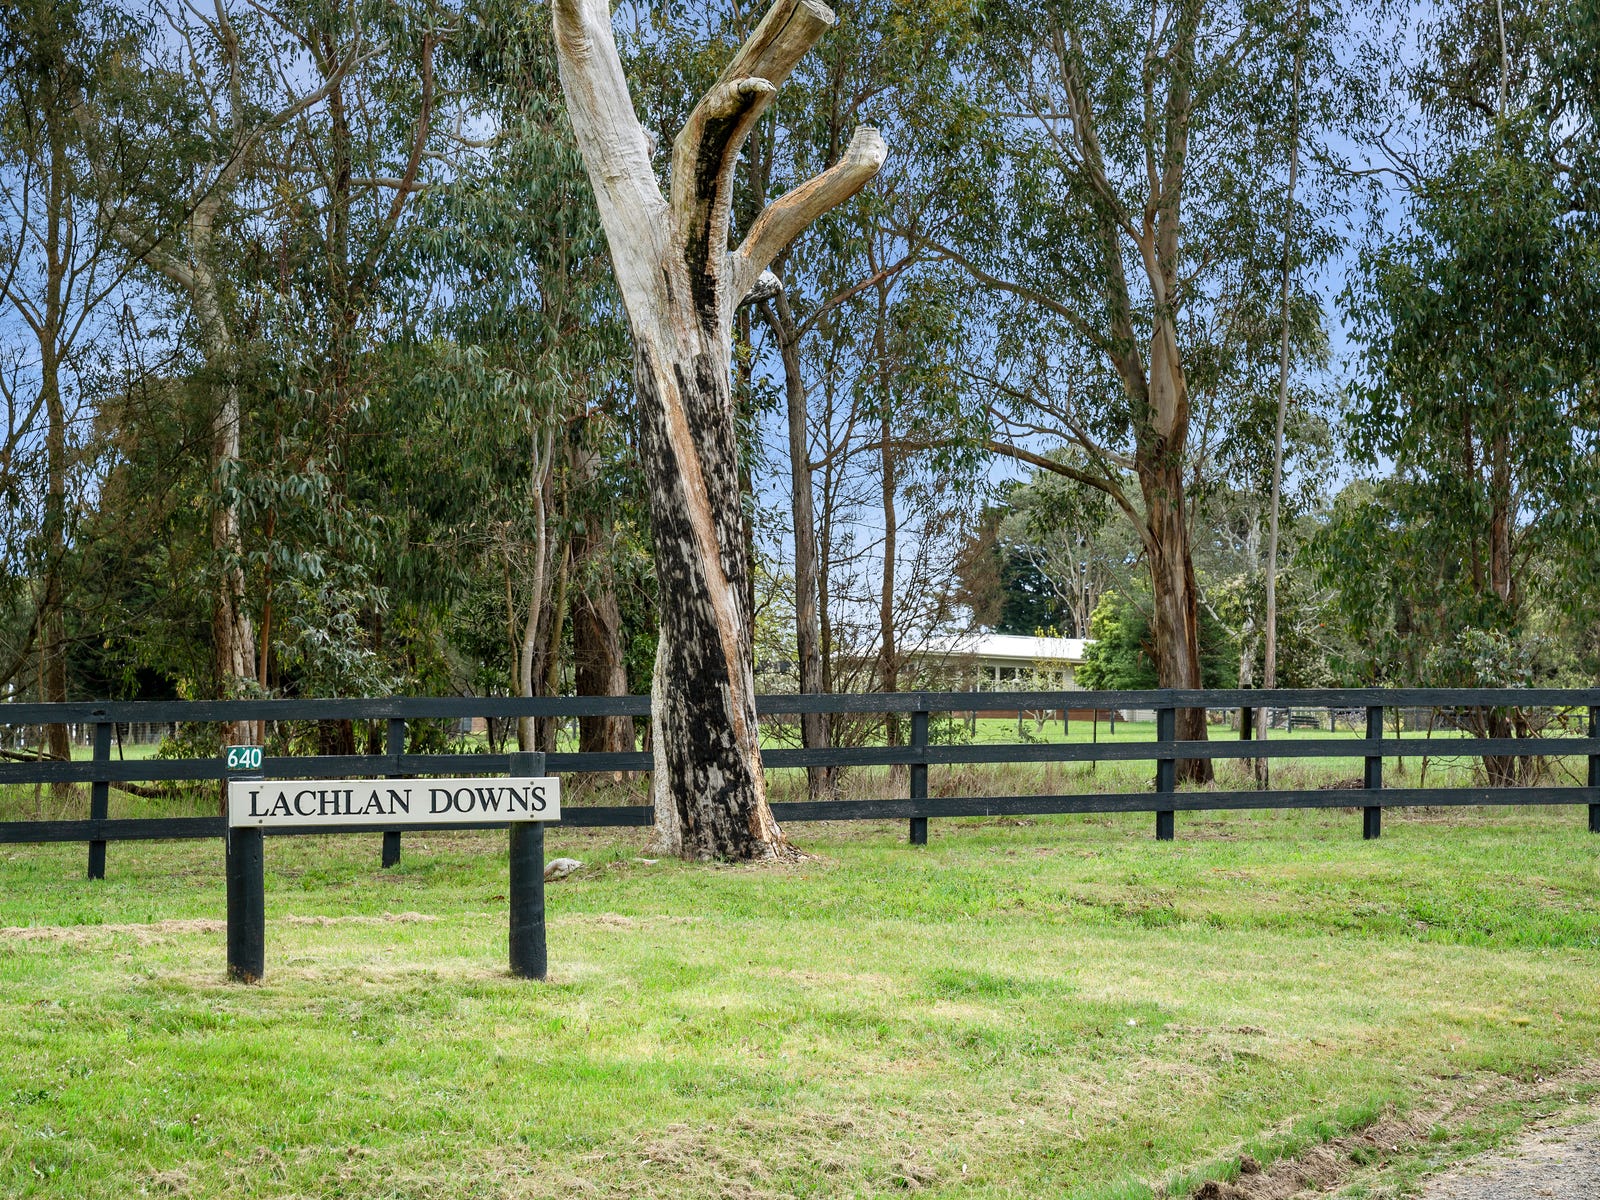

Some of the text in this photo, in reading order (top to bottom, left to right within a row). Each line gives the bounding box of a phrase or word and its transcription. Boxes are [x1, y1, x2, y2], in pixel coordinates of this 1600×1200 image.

[227, 748, 261, 769] 640
[248, 786, 547, 817] LACHLAN DOWNS
